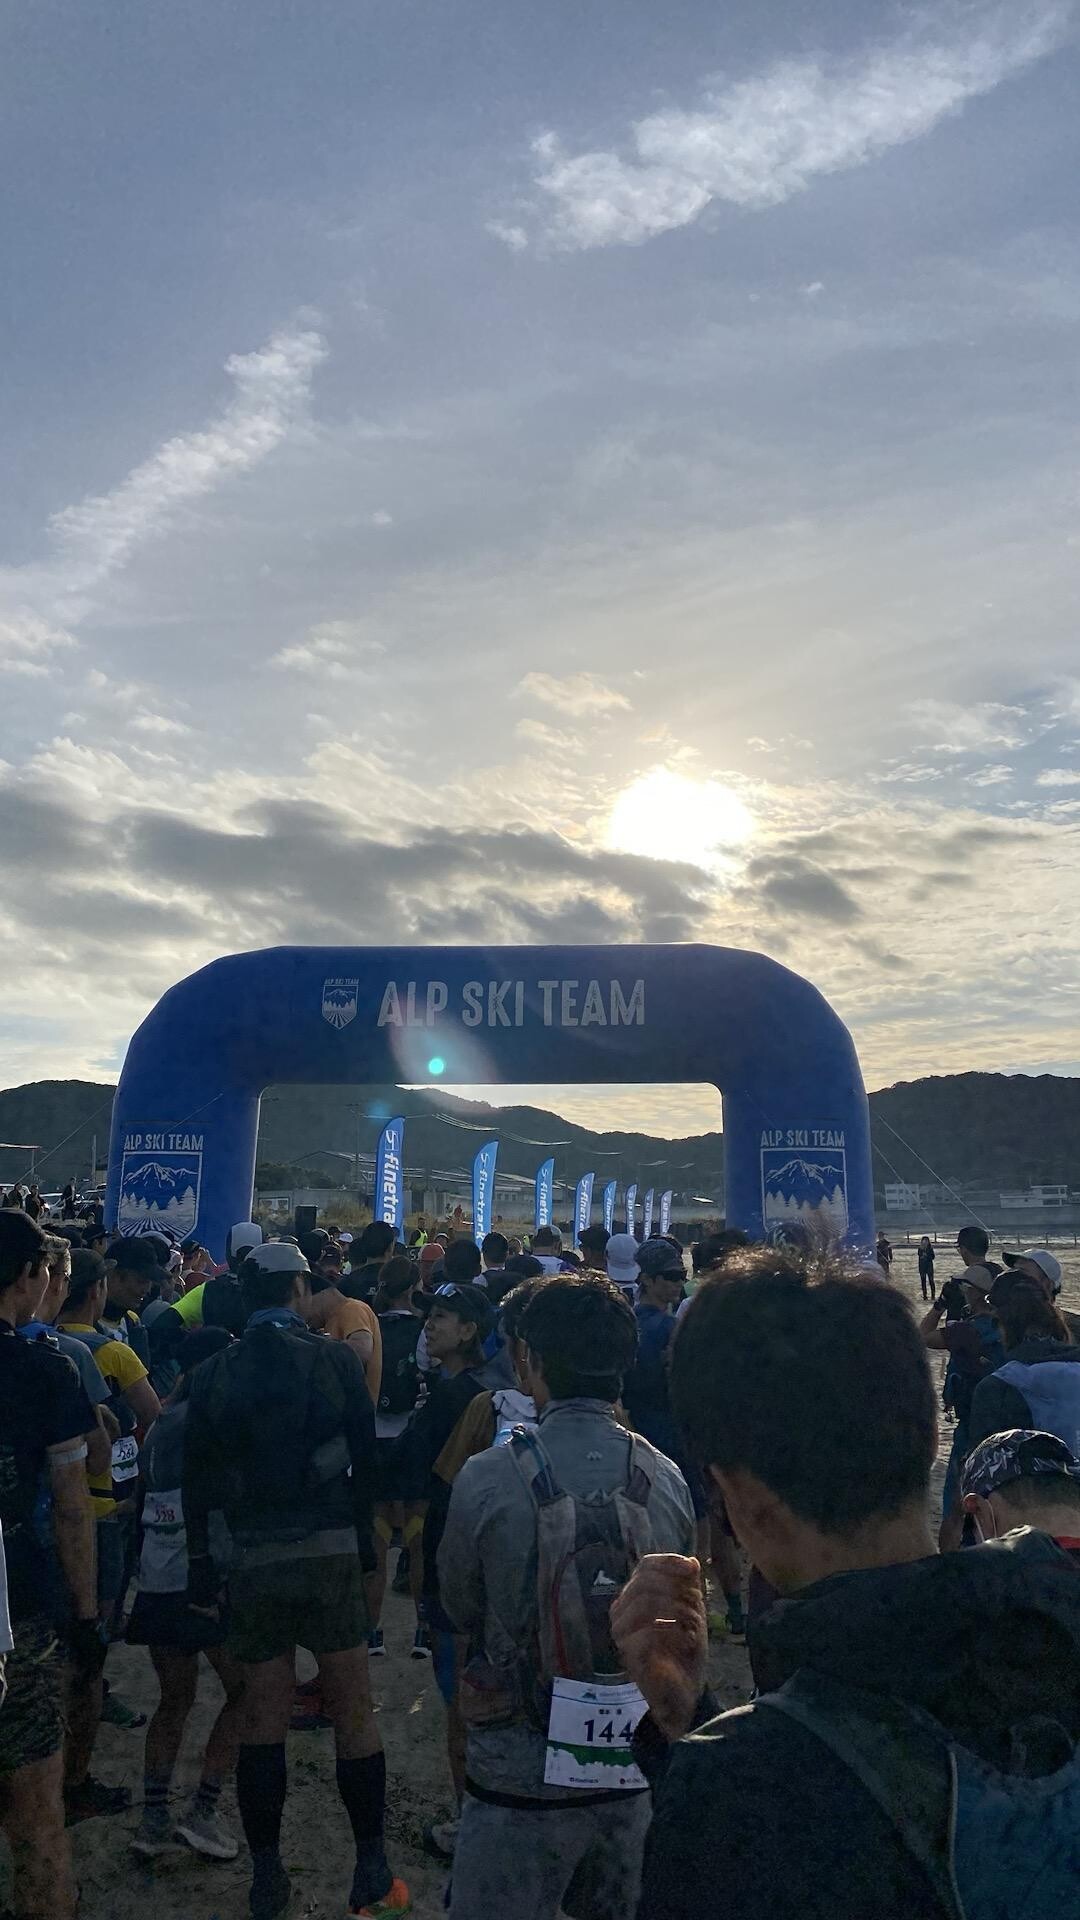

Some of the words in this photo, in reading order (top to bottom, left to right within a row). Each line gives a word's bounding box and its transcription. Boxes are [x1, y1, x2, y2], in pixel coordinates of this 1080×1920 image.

[377, 980, 448, 1027] ALP
[461, 980, 525, 1027] SKI
[538, 979, 645, 1026] TEAM
[124, 1134, 142, 1150] ALP
[145, 1134, 165, 1150] SKI
[168, 1134, 204, 1150] TEAM
[760, 1130, 783, 1147] ALP
[786, 1130, 808, 1146] SKI
[811, 1130, 845, 1147] TEAM
[383, 1152, 399, 1228] finetra
[539, 1181, 549, 1226] finetra
[579, 1191, 589, 1232] finetra
[584, 1719, 634, 1743] 144
